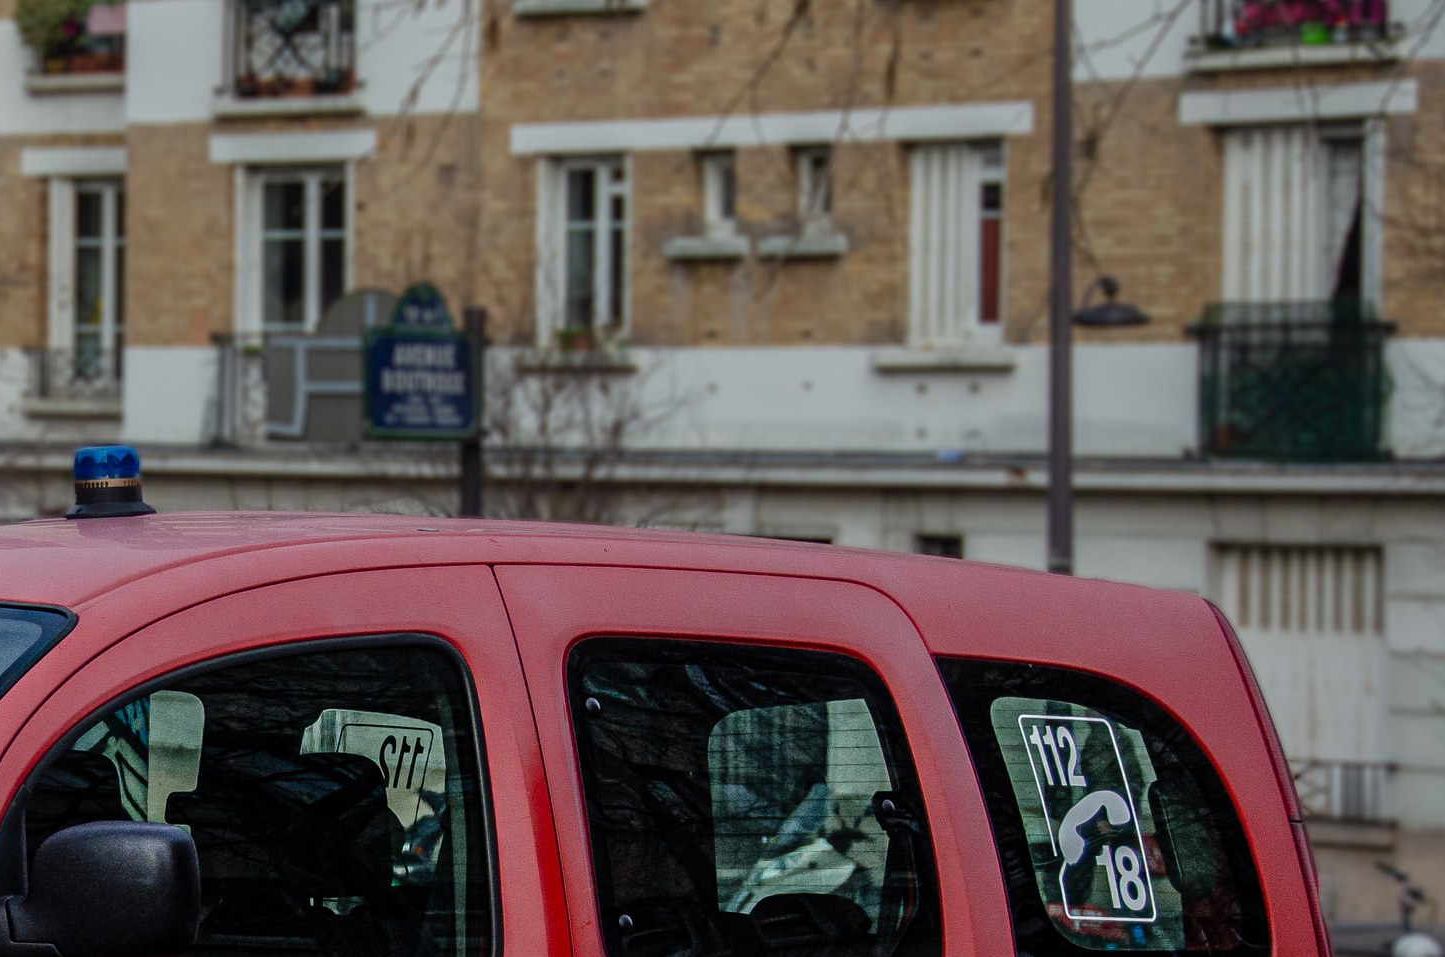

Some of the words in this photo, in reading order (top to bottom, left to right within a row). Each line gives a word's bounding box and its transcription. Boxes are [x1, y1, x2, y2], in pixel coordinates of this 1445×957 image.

[393, 343, 457, 369] AVENUE
[1029, 725, 1087, 787] 112
[1096, 845, 1147, 911] 18
